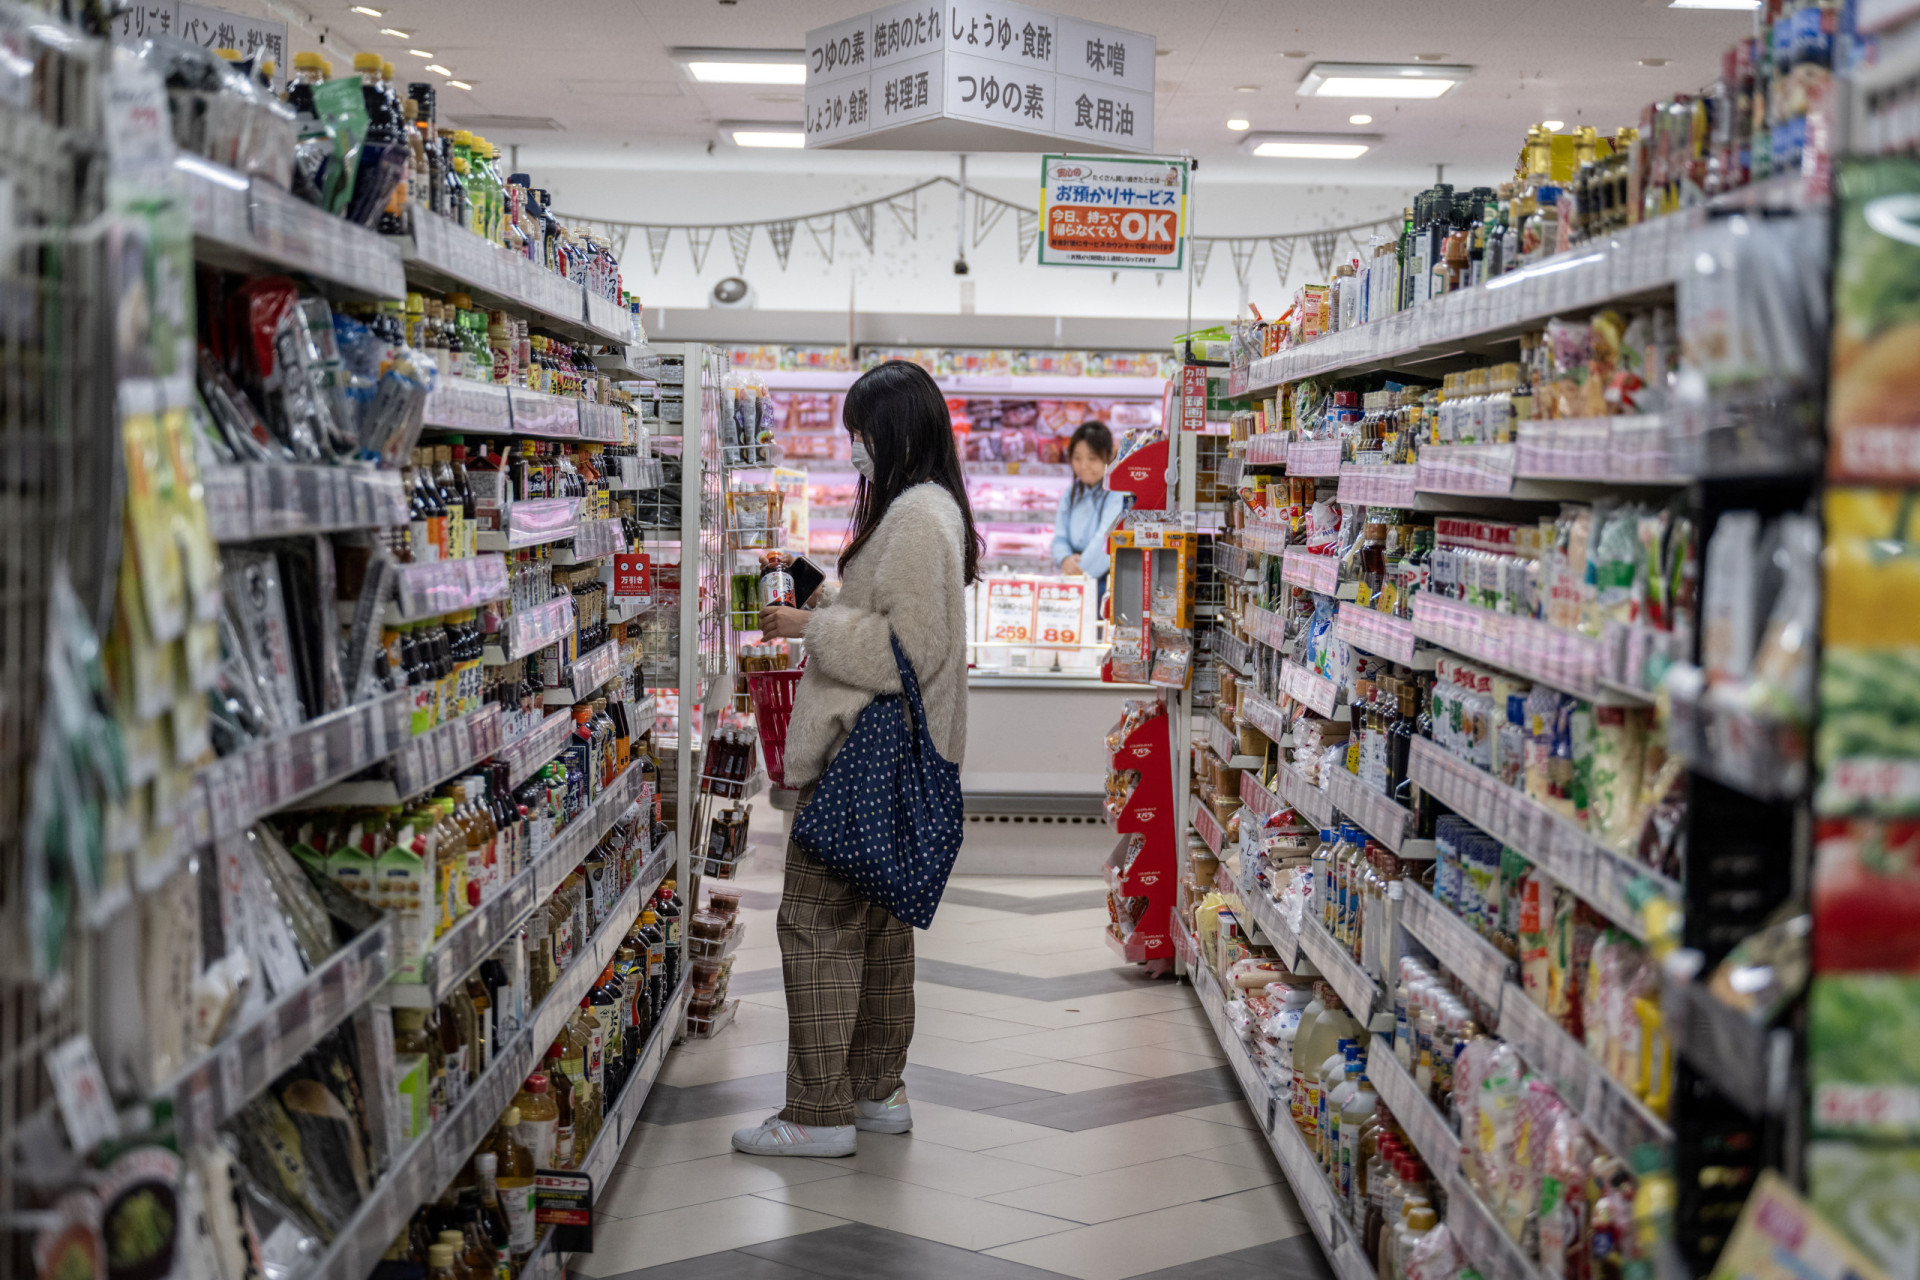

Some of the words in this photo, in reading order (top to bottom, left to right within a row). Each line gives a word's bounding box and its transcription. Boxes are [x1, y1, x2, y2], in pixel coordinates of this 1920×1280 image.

[873, 7, 941, 58] 焼肉のたれ
[952, 7, 1052, 61] しょうゆ・食酢
[812, 30, 865, 74] つゆの素
[1086, 38, 1125, 77] 味噌
[885, 71, 929, 115] 料理酒
[958, 75, 1044, 120] つゆの素
[806, 87, 868, 133] しょうゆ・食酢
[1075, 93, 1134, 136] 食用油
[1056, 185, 1176, 205] お預かりサービス
[1052, 209, 1121, 224] 今日、持って
[1053, 223, 1118, 238] 帰らなくても
[1120, 212, 1172, 242] OK
[1185, 368, 1195, 395] カメラ
[1195, 368, 1206, 386] 防犯
[1184, 396, 1203, 430] 録画中
[621, 575, 643, 585] 万引き
[995, 625, 1027, 640] 259
[1043, 628, 1075, 643] 89
